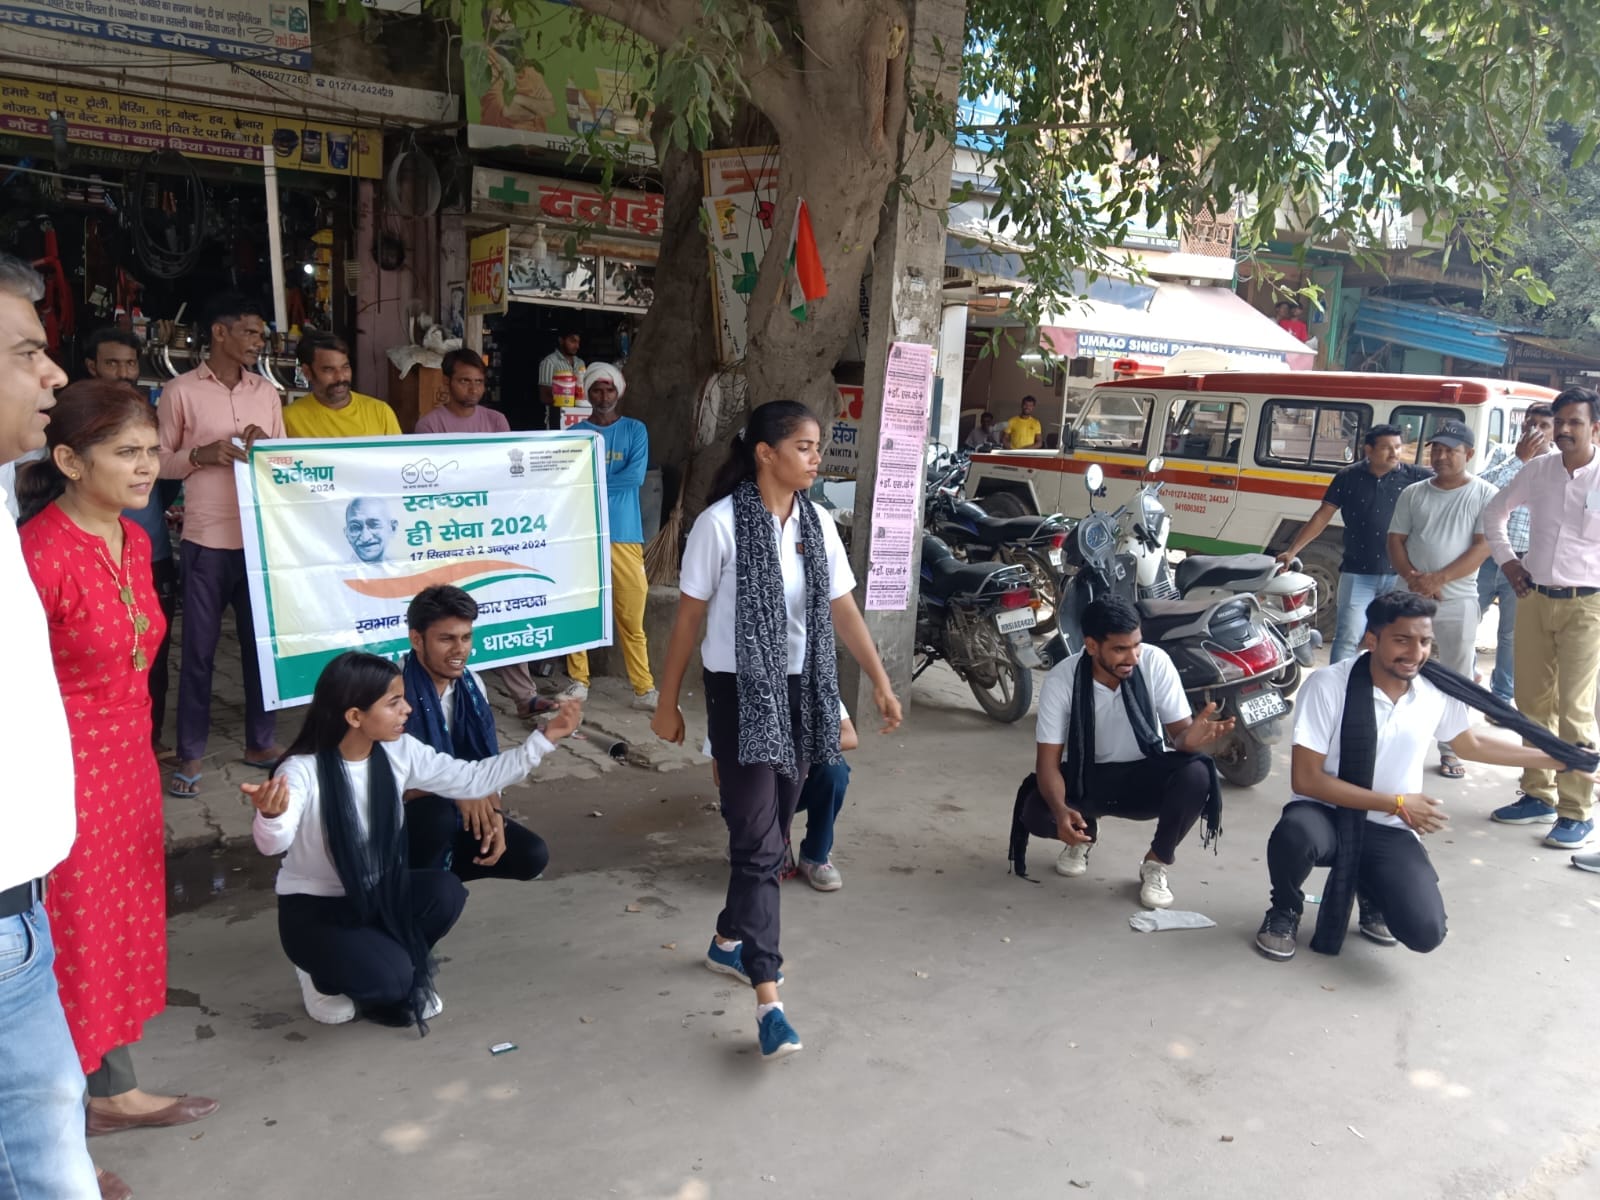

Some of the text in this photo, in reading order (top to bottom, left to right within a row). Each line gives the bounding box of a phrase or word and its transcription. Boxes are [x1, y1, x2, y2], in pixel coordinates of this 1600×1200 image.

[35, 15, 100, 34] भगत
[160, 33, 210, 50] चौक
[64, 95, 79, 105] पर
[8, 119, 39, 133] नोट
[108, 130, 129, 145] का
[134, 135, 165, 149] काम
[169, 137, 203, 154] किया
[207, 144, 239, 158] जाता
[192, 127, 204, 138] रेट
[206, 129, 219, 140] पर
[1079, 335, 1127, 350] UMRAO
[1128, 339, 1169, 354] SINGH
[272, 460, 336, 485] सर्वेक्षण
[310, 483, 336, 494] 2024
[402, 491, 489, 513] स्वच्छता
[405, 514, 548, 546] ही सेवा 2024
[411, 551, 424, 562] 17
[467, 544, 478, 557] से
[479, 544, 485, 555] 2
[522, 538, 548, 551] 2024
[355, 614, 400, 634] स्वभाव
[505, 594, 548, 612] स्वच्छता
